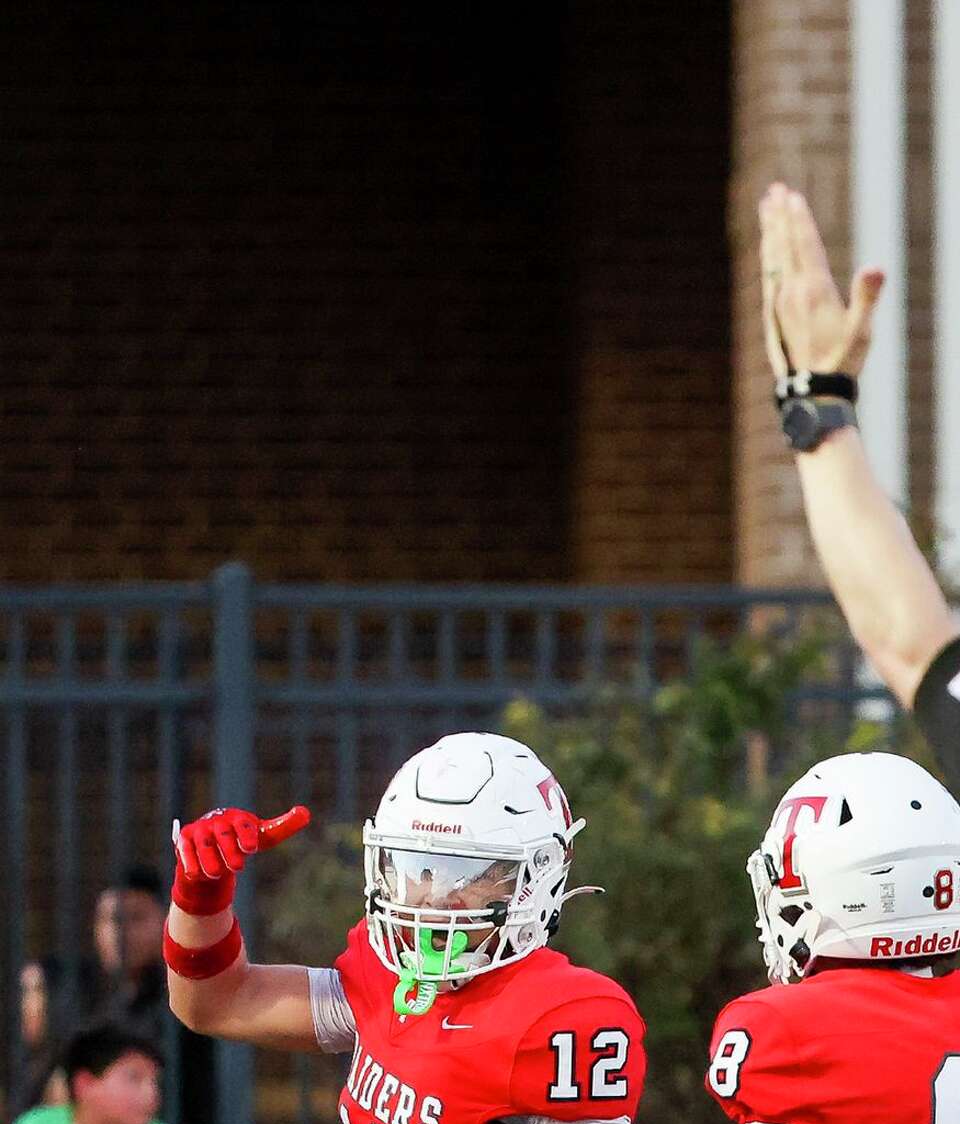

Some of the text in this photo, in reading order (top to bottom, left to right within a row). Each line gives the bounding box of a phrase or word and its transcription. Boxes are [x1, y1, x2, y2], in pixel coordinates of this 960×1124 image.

[411, 820, 462, 834] Riddell
[774, 796, 829, 890] T
[932, 869, 954, 910] 8
[547, 1027, 630, 1101] 12
[708, 1028, 753, 1099] 8
